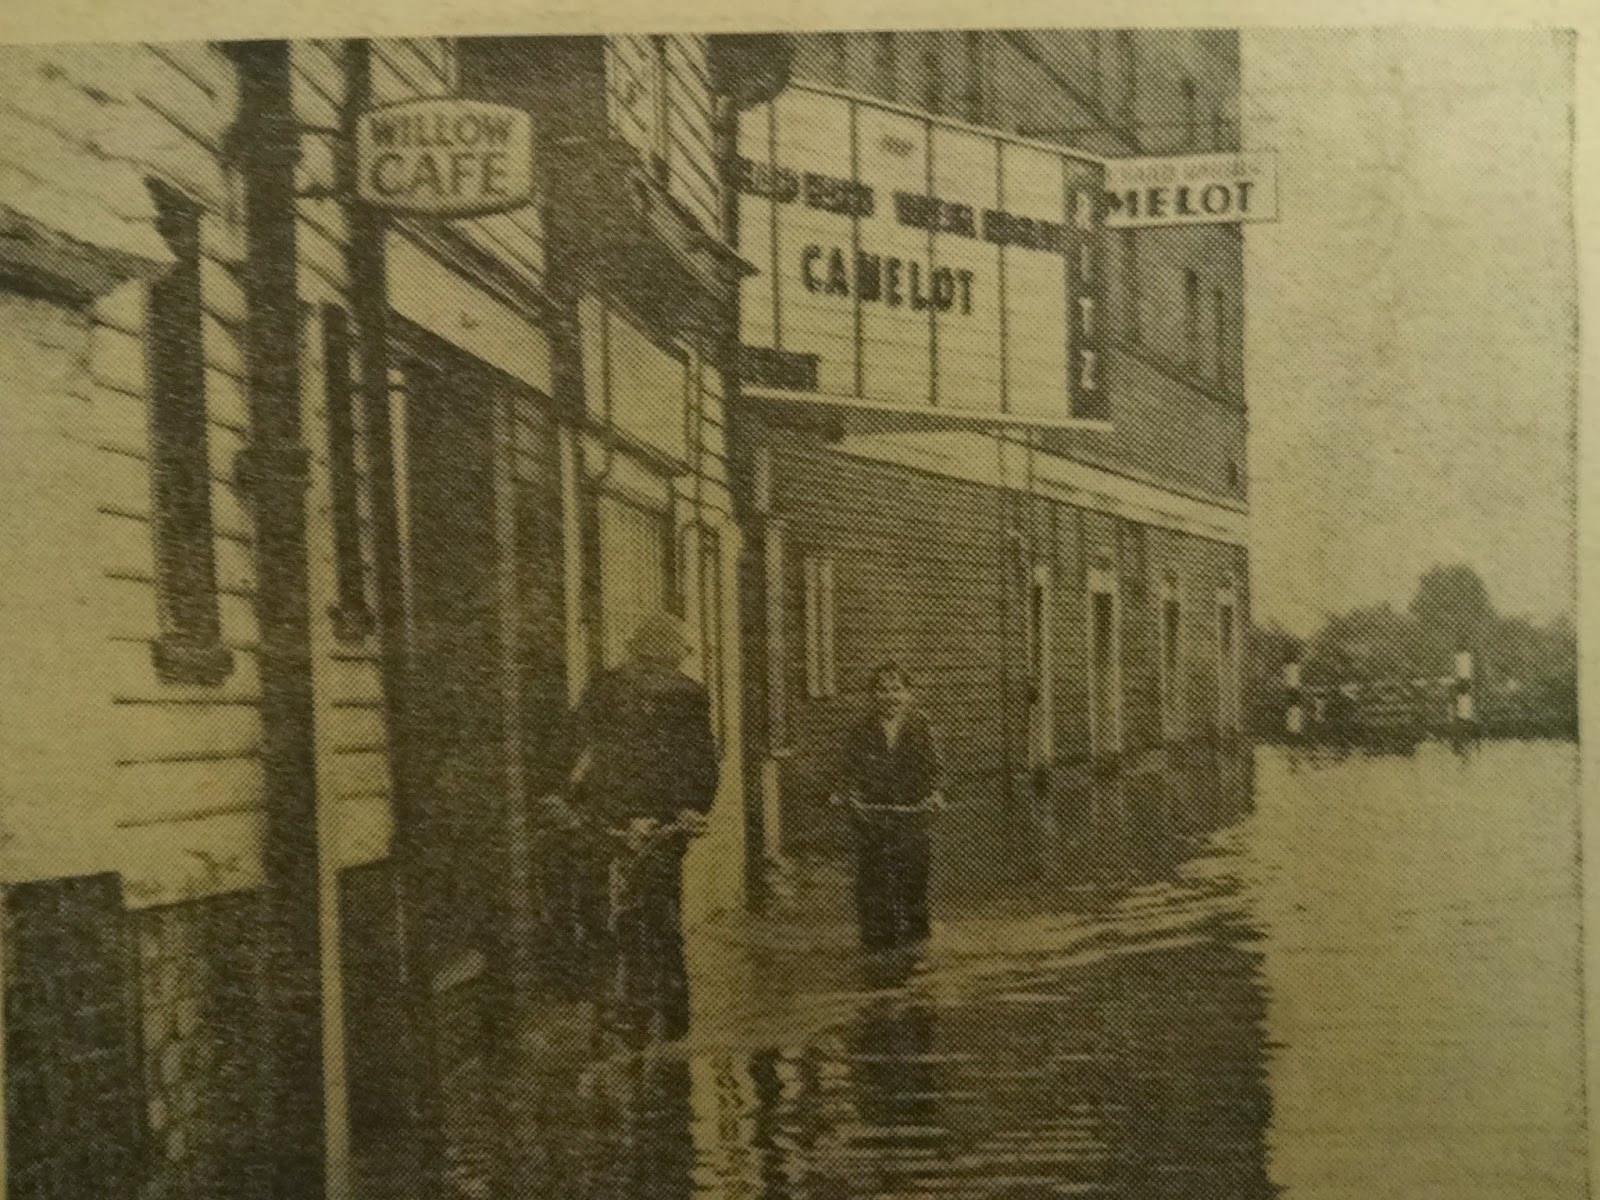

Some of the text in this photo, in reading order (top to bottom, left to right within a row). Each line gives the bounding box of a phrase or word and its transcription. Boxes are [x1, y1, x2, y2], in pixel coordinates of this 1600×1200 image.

[370, 112, 515, 146] WILLOW
[371, 152, 508, 197] CAFE
[803, 243, 976, 317] CAMELOT
